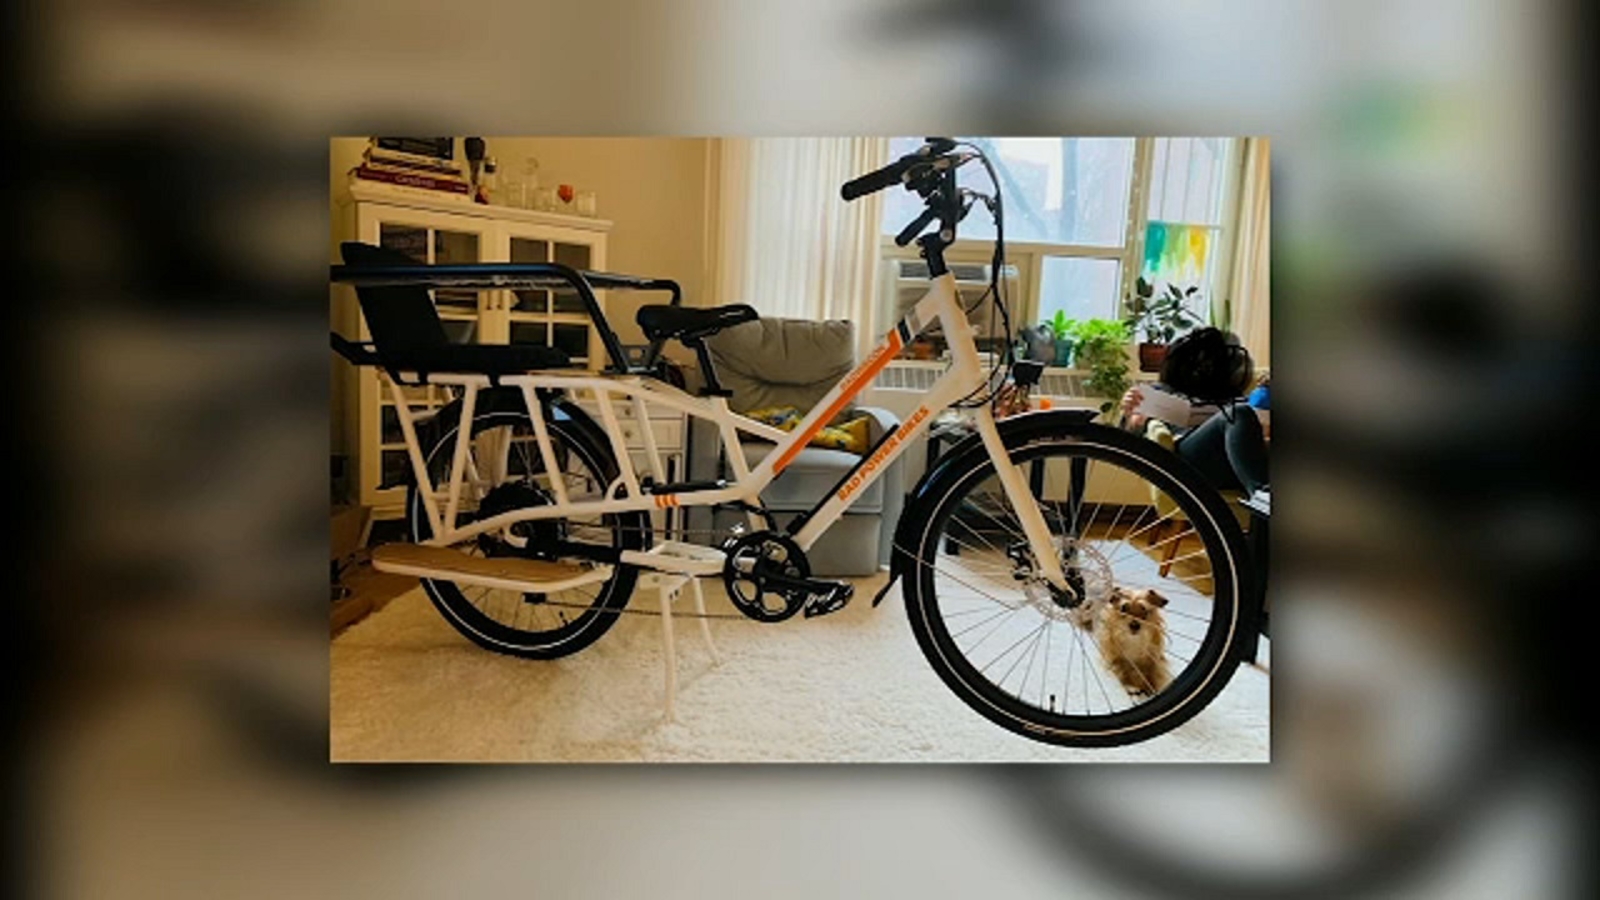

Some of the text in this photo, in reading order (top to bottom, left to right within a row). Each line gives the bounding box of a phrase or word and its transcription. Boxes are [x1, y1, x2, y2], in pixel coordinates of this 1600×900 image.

[838, 406, 929, 500] RAD POWER BIKES
